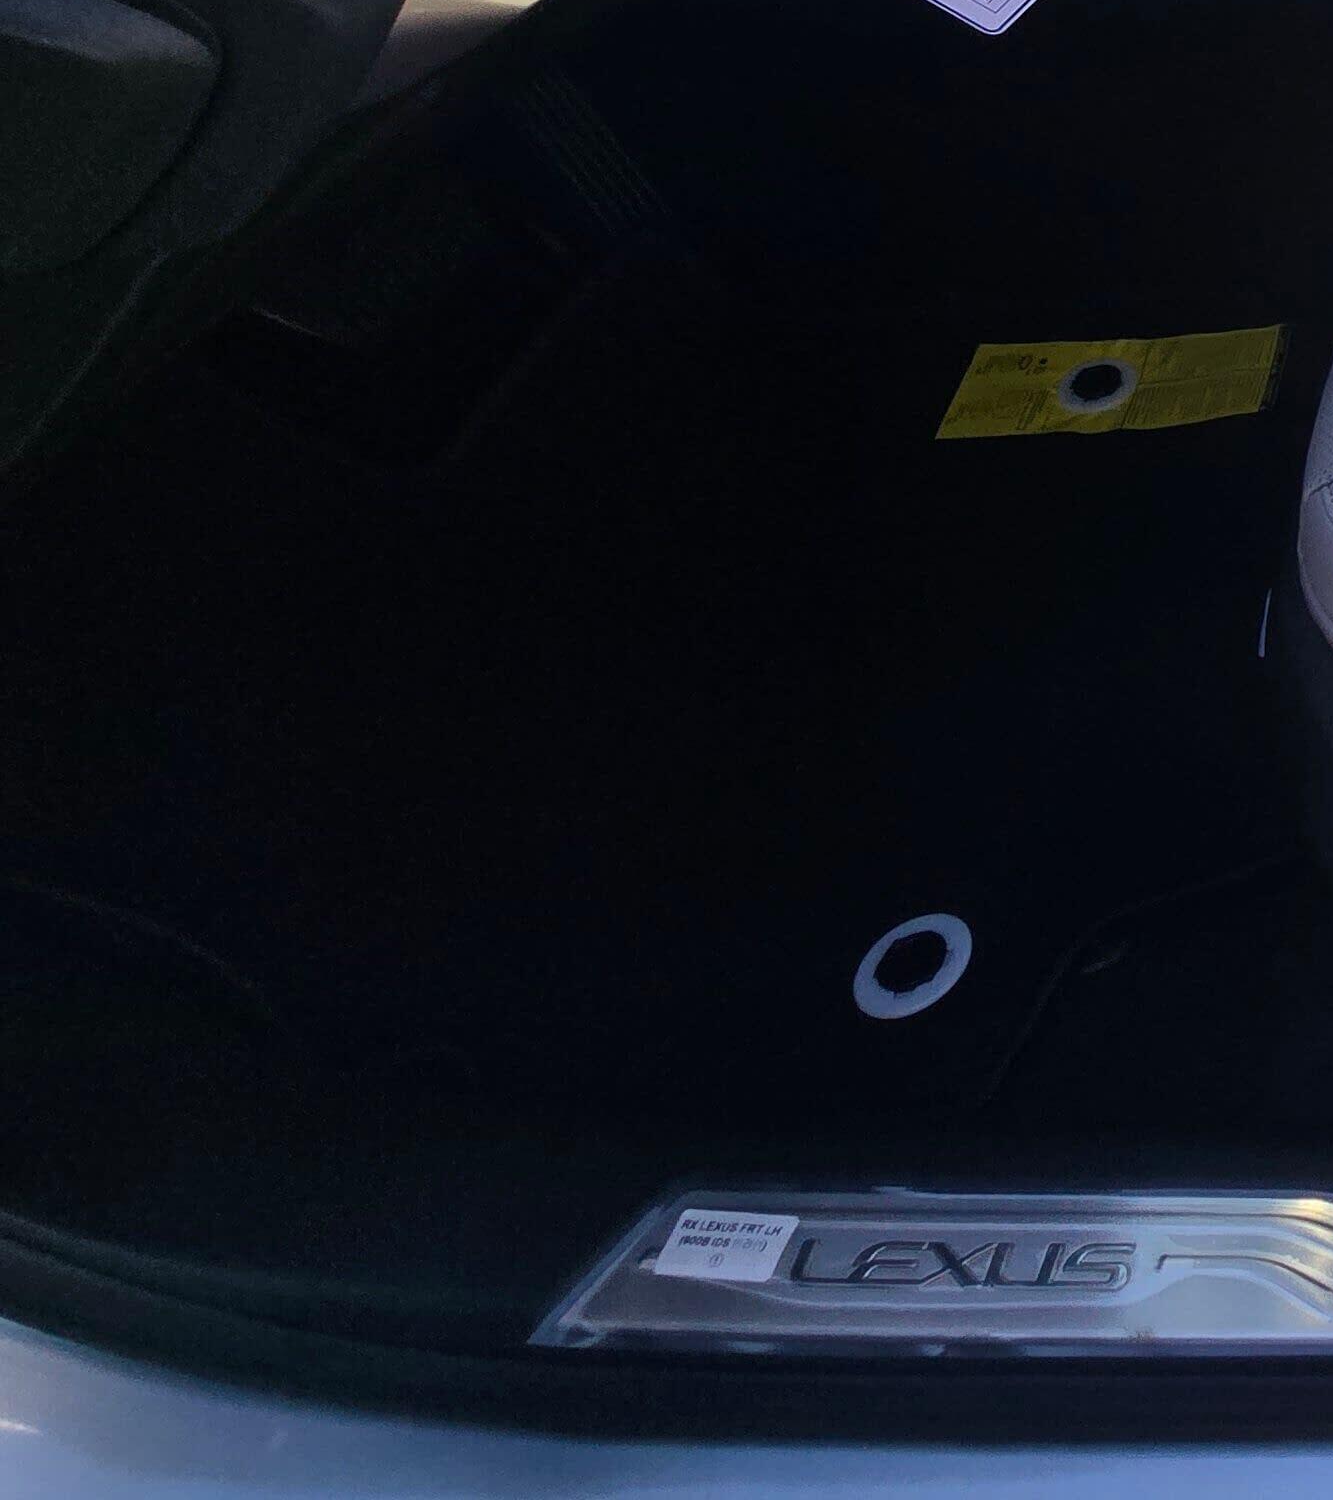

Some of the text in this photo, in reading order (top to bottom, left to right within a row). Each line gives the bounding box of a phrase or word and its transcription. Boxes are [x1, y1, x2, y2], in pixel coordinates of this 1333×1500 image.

[681, 1219, 699, 1230] RX
[701, 1220, 738, 1232] LEXUS
[740, 1223, 765, 1235] FRT
[790, 1237, 1137, 1291] LEXUS
